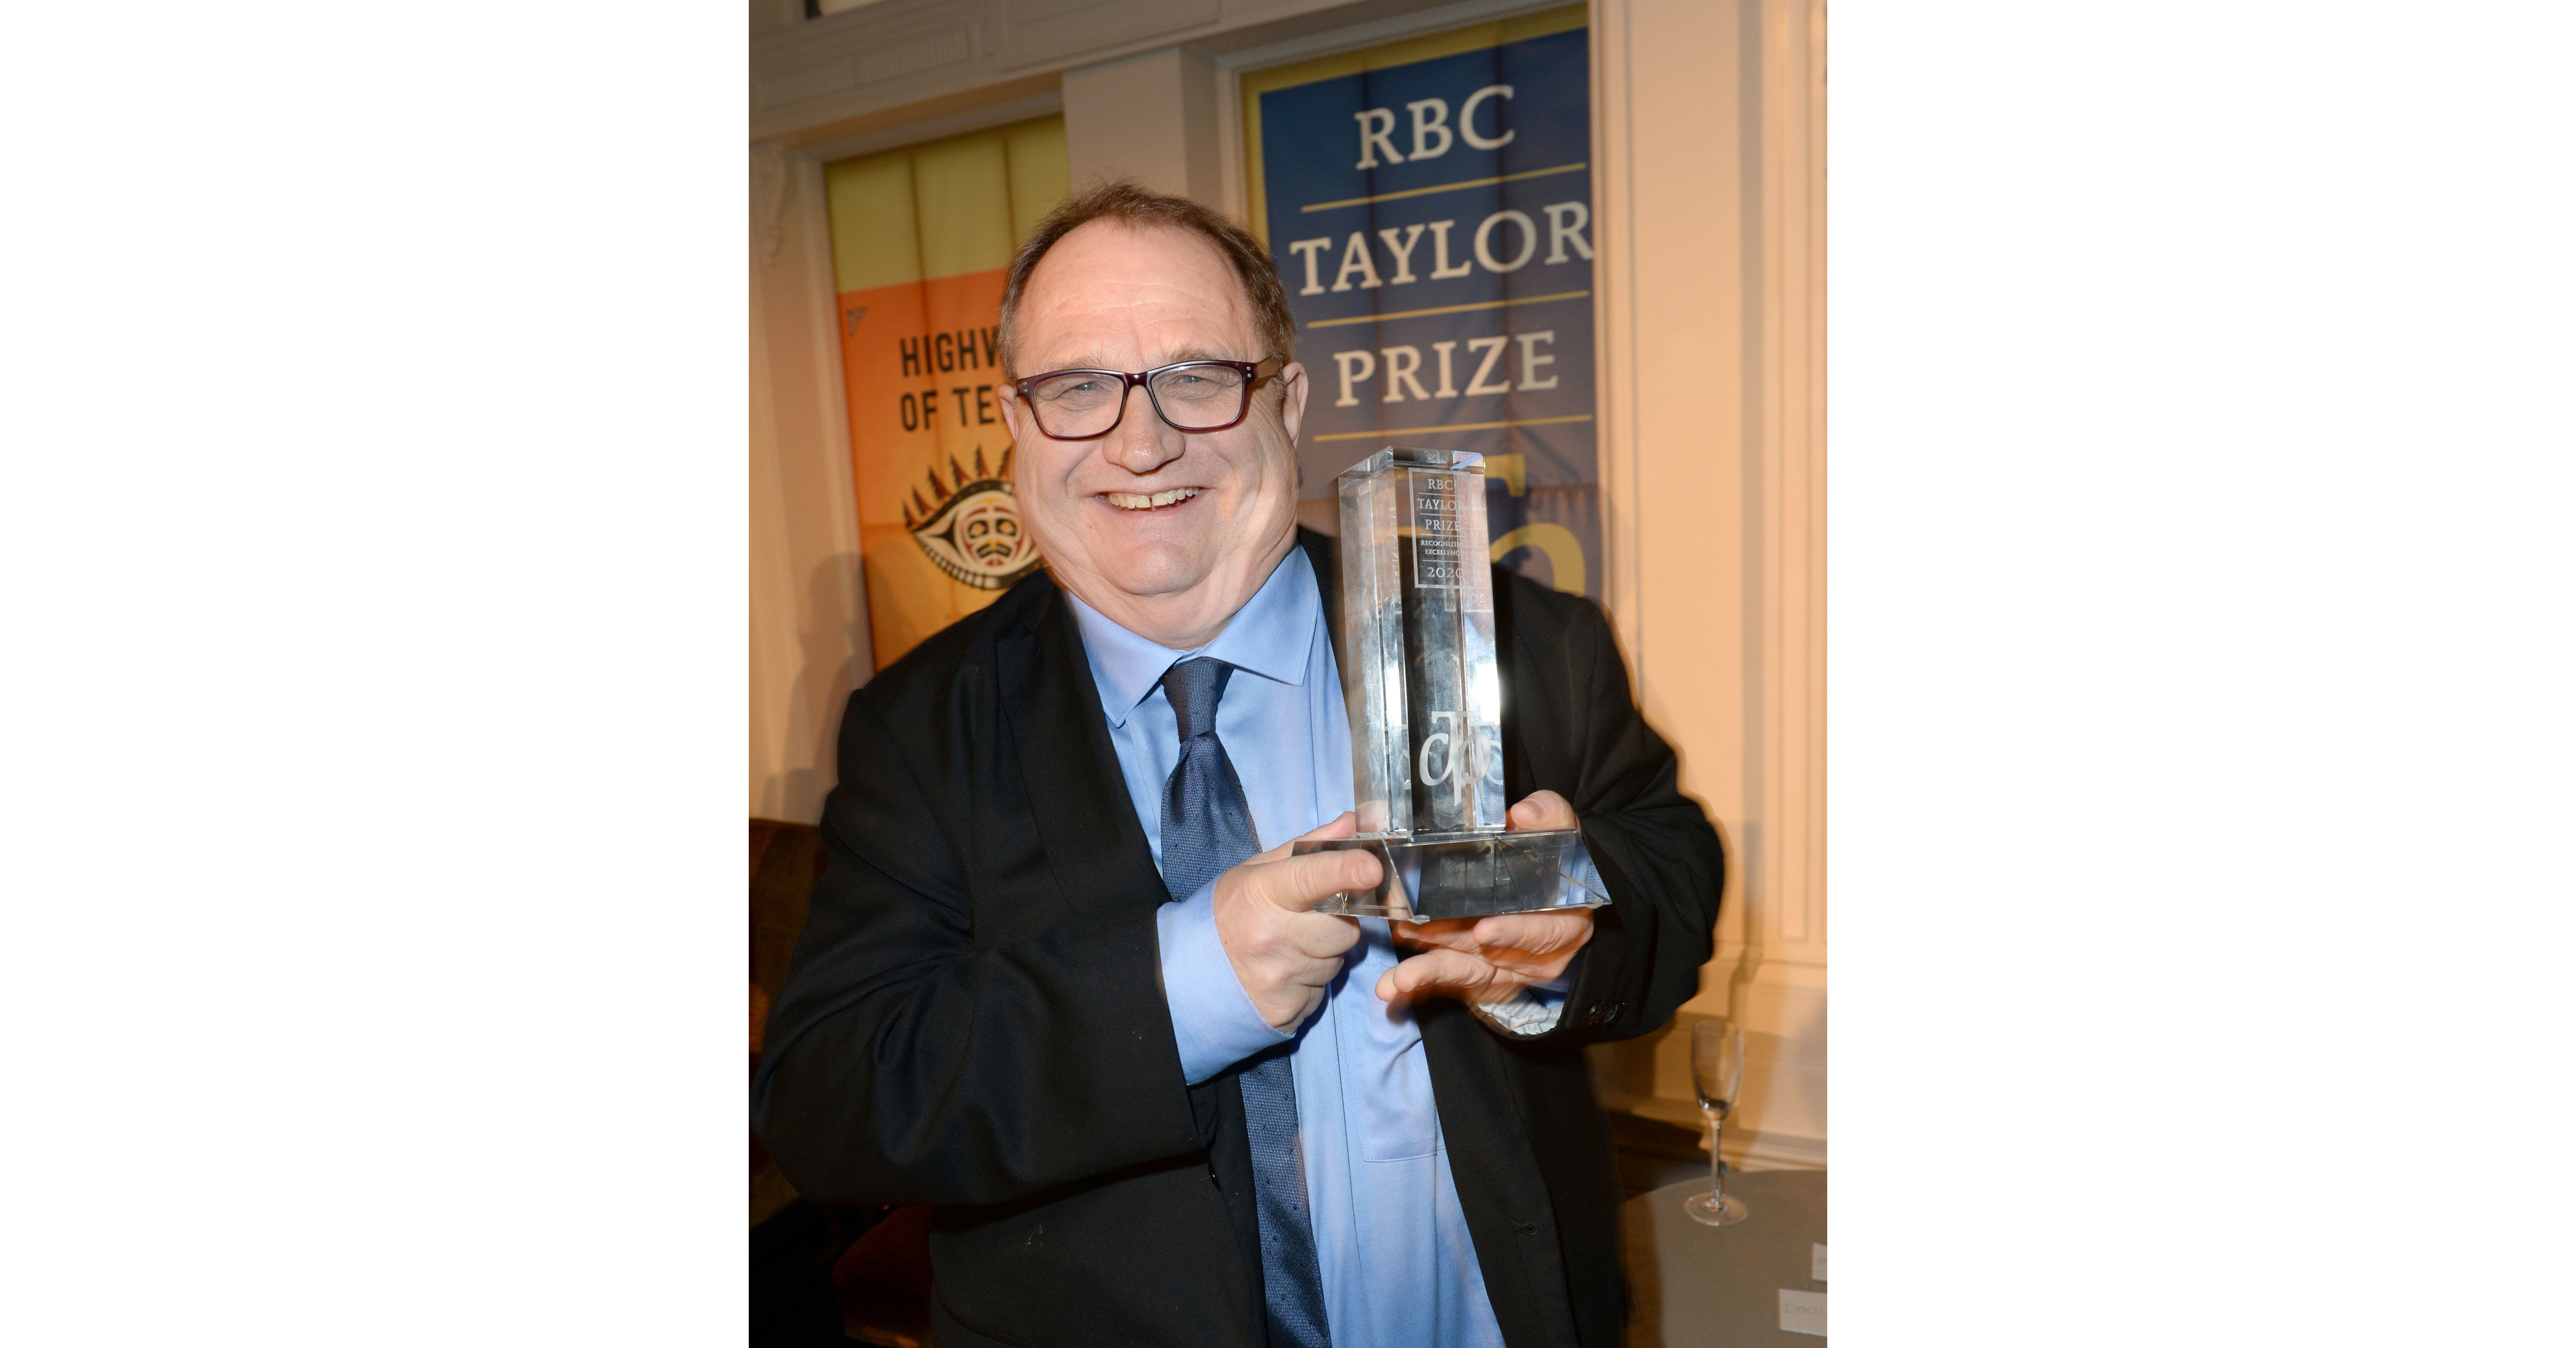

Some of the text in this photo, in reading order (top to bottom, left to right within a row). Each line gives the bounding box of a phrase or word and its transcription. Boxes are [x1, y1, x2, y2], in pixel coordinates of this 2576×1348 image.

[1354, 84, 1515, 170] RBC
[1290, 201, 1594, 296] TAYLOR
[1333, 330, 1558, 407] PRIZE
[901, 384, 1006, 431] OF TE
[1427, 478, 1453, 490] RBC
[1417, 498, 1464, 511] TAYLOR
[1425, 518, 1461, 531] PRIZE
[1427, 566, 1464, 578] 2020
